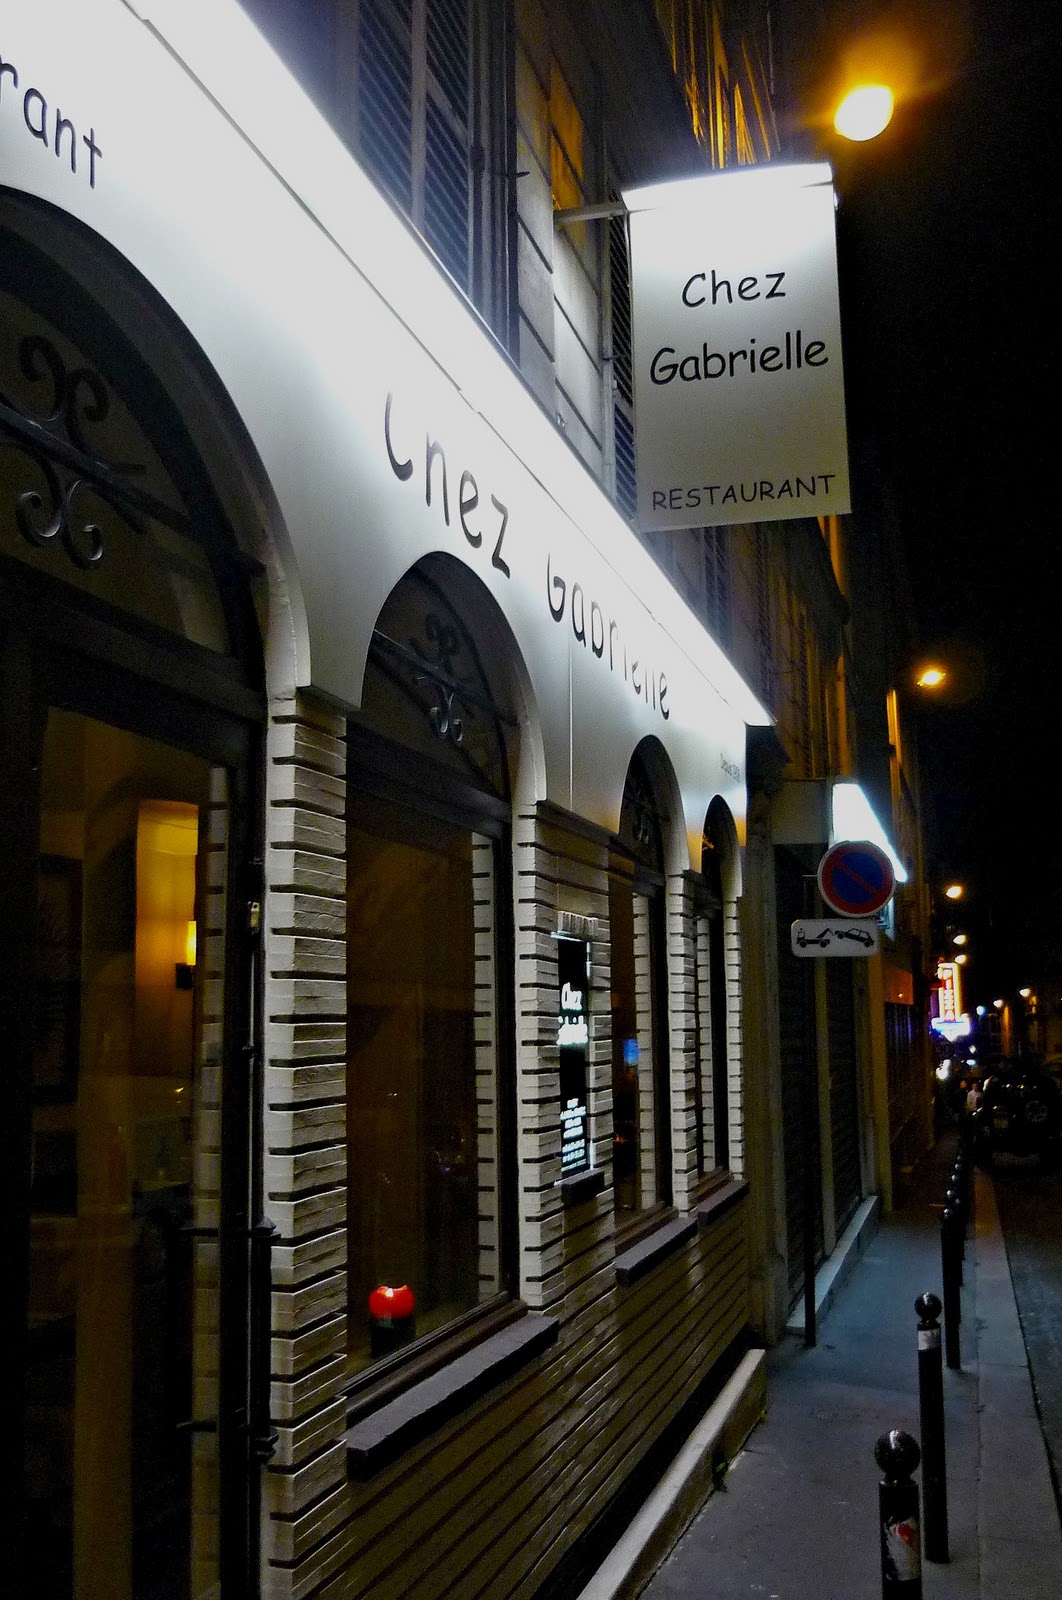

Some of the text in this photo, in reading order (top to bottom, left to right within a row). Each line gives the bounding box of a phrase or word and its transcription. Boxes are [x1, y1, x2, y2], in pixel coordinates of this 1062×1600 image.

[682, 270, 786, 308] Chez
[650, 330, 828, 385] Gabrielle
[652, 474, 836, 511] RESTAURANT
